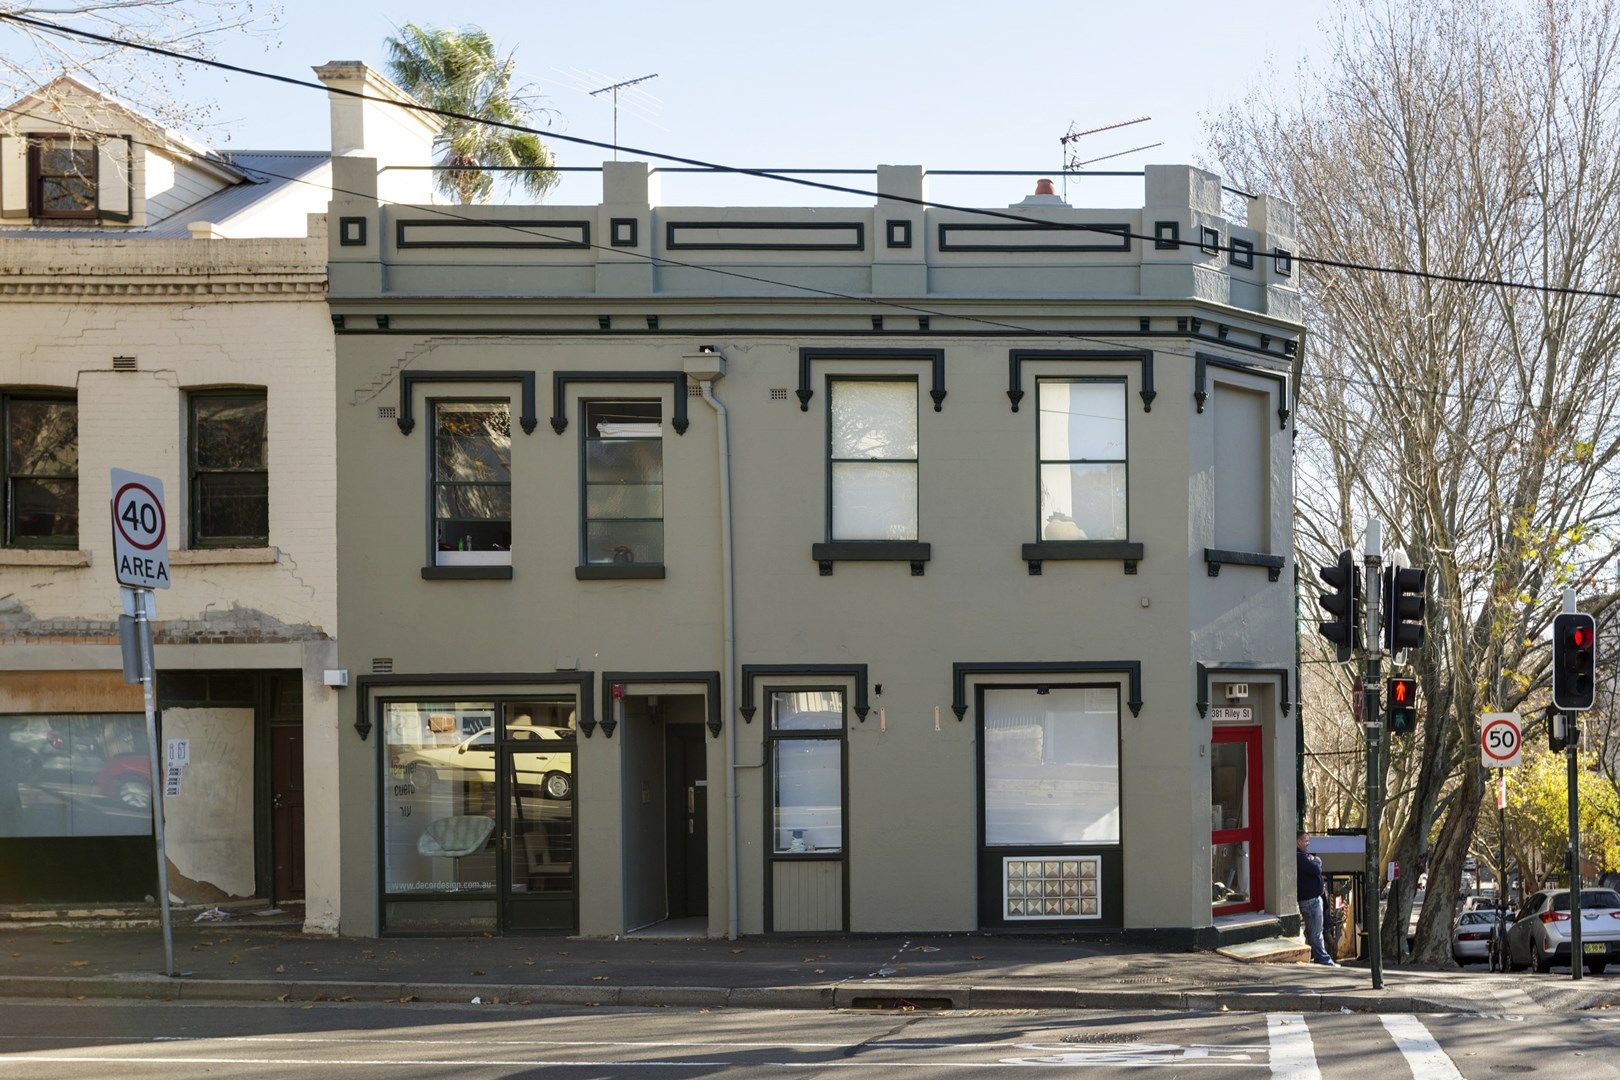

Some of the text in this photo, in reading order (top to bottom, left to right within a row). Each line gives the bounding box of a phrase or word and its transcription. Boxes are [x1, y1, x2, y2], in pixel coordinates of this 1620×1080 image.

[121, 500, 157, 534] 40
[120, 555, 168, 581] AREA
[1211, 708, 1250, 720] 381 Riley St
[1490, 730, 1514, 748] 50
[391, 880, 492, 890] www.decordesign.com.au
